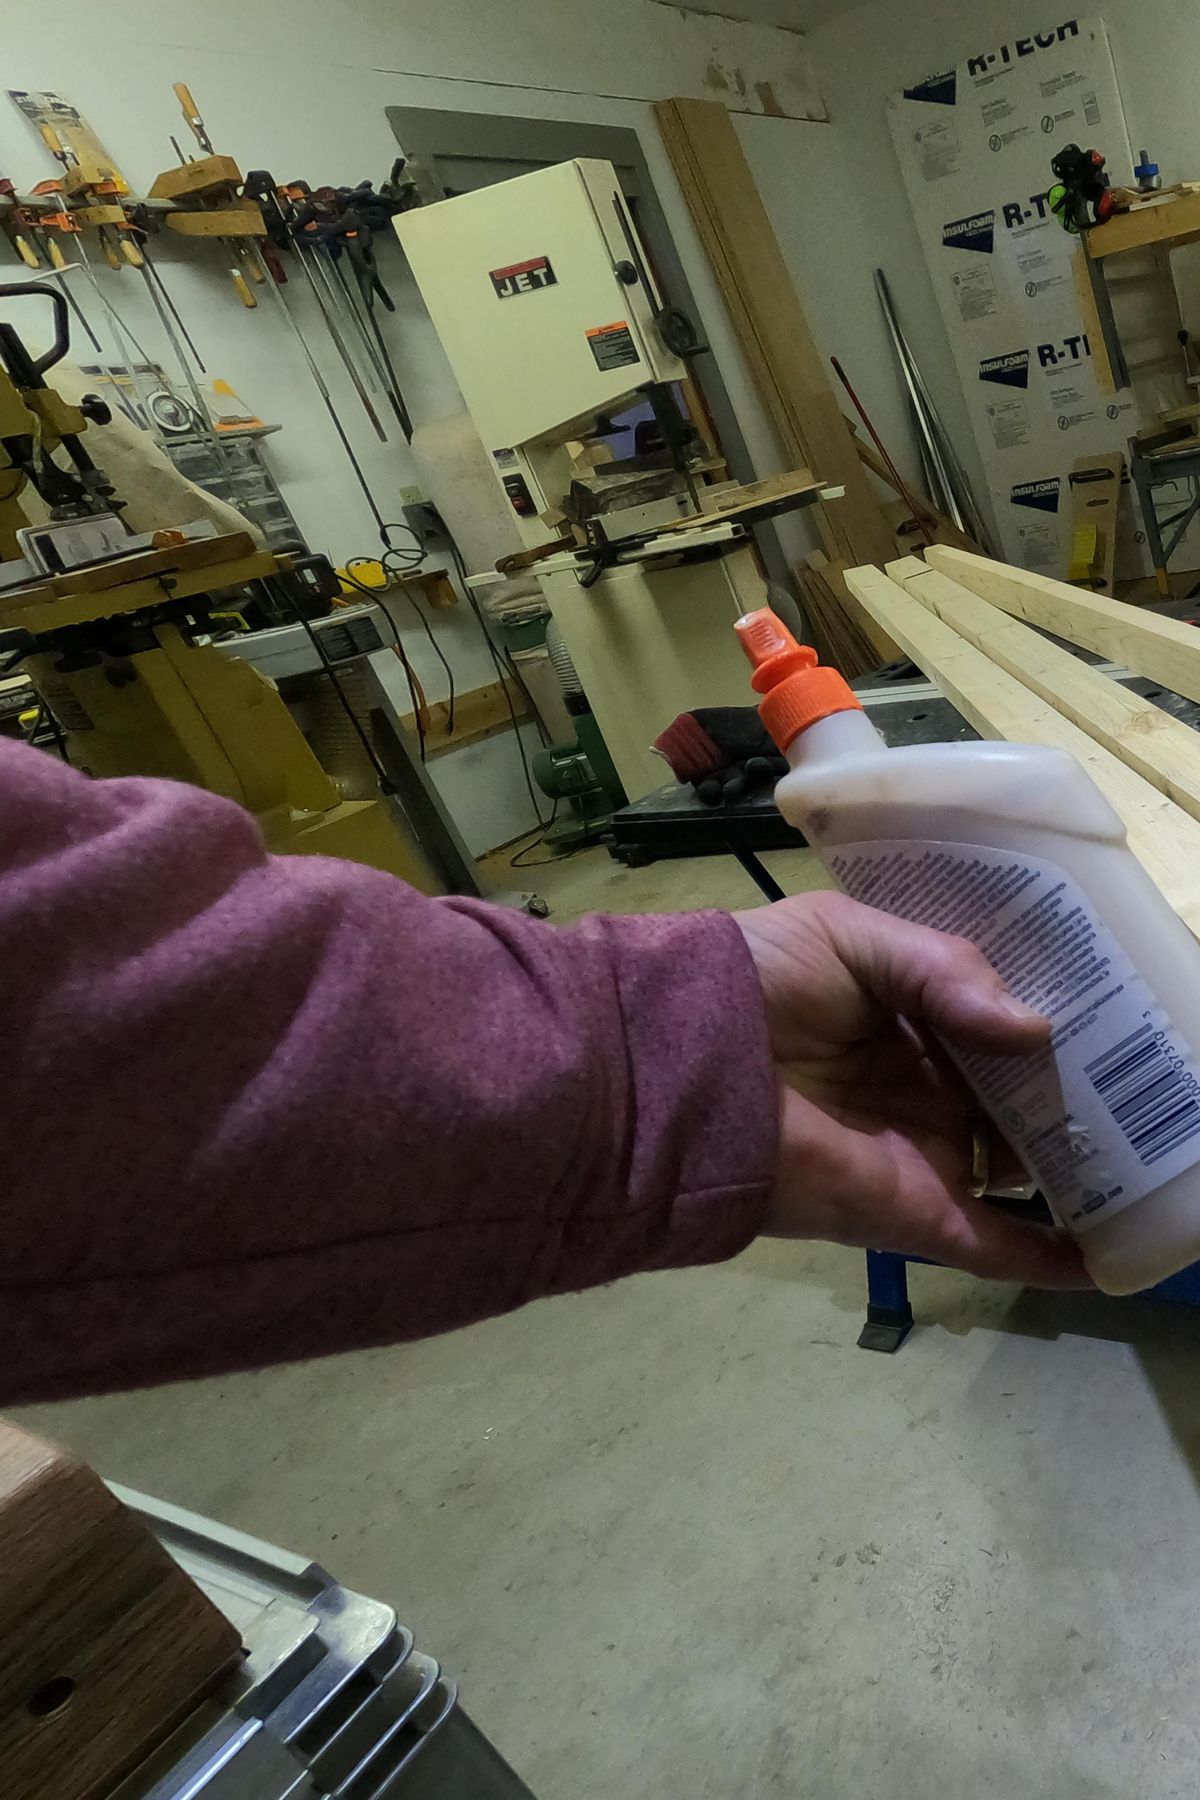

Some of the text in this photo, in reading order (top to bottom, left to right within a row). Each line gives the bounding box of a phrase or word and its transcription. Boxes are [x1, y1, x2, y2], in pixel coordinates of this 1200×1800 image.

[1002, 192, 1051, 229] R-T
[500, 267, 548, 297] JET
[1153, 1031, 1186, 1070] 07310
